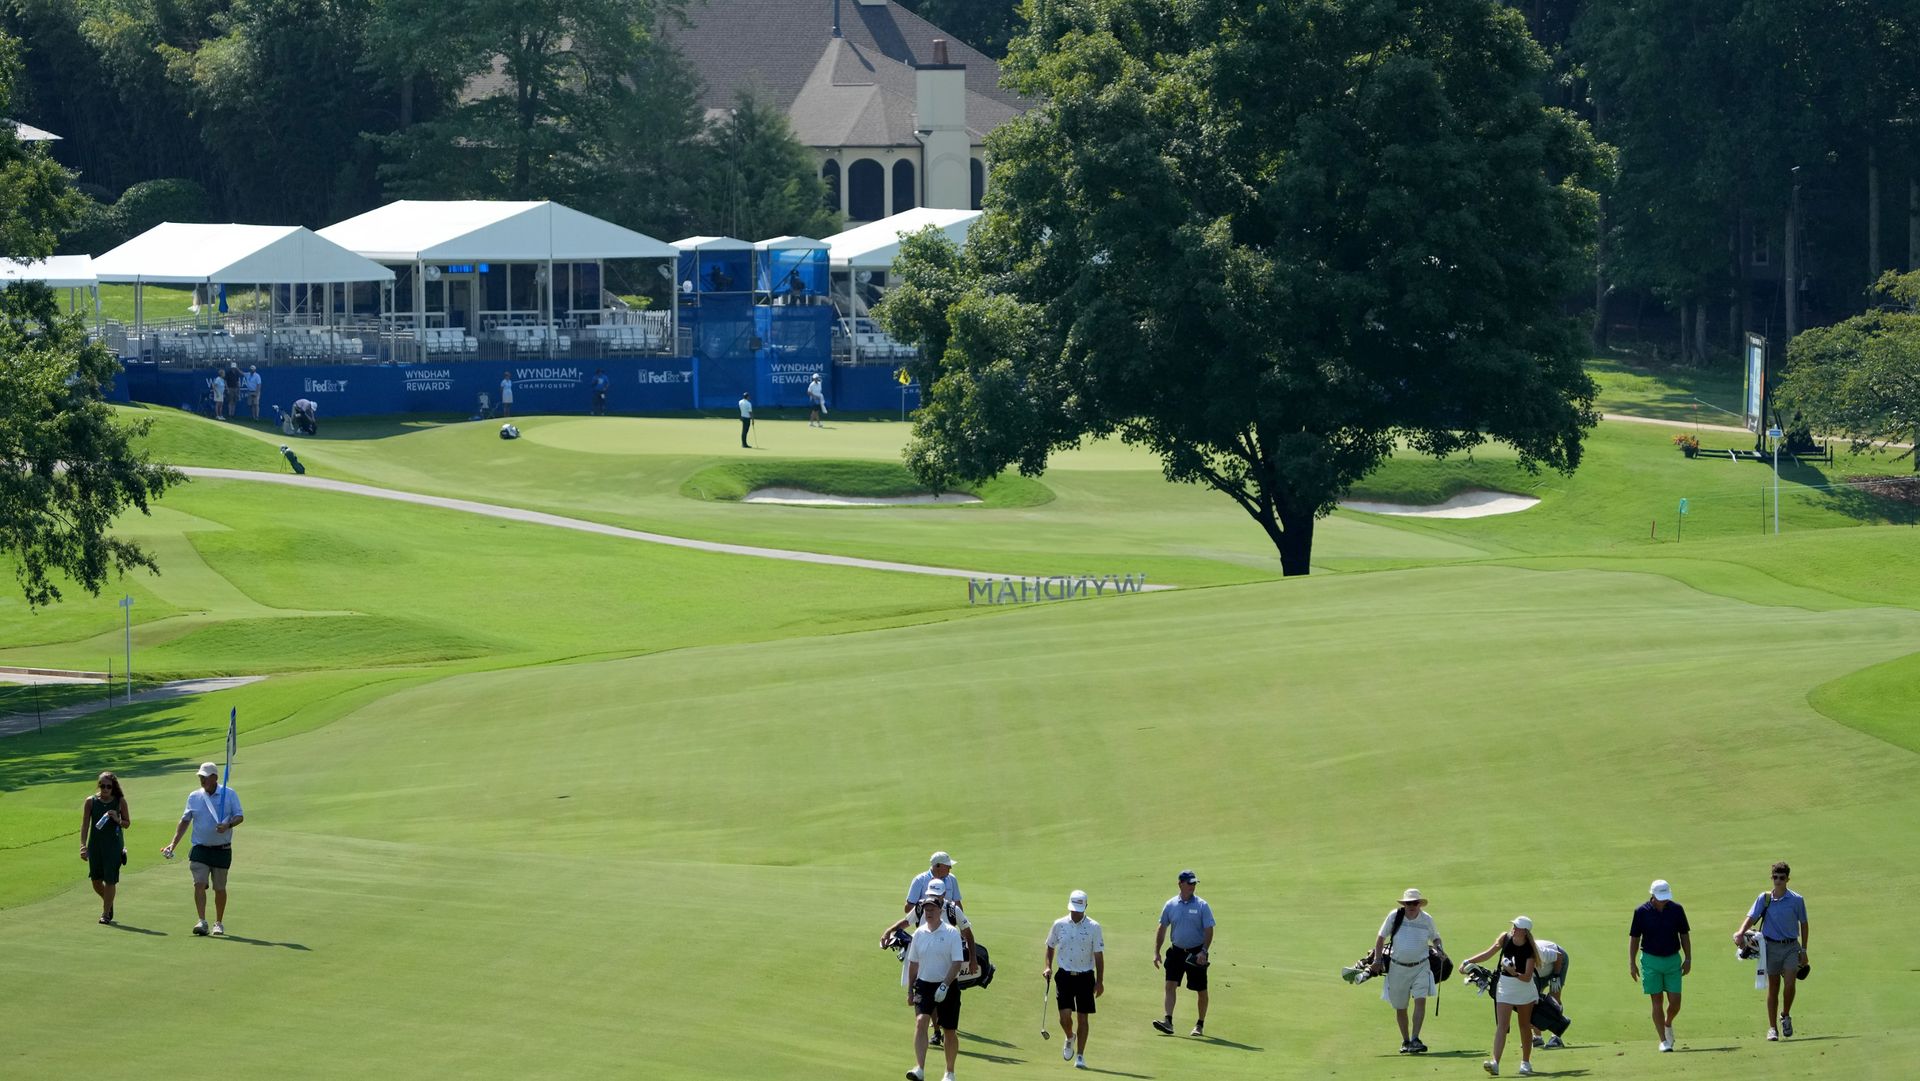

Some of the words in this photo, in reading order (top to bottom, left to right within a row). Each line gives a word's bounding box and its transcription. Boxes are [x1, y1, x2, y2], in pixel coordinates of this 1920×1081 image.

[771, 363, 824, 372] WYNDHAM
[405, 369, 450, 379] WYNDHAM
[516, 367, 577, 379] WYNDHAM
[772, 375, 823, 384] REWARS
[406, 381, 450, 391] REWARDS
